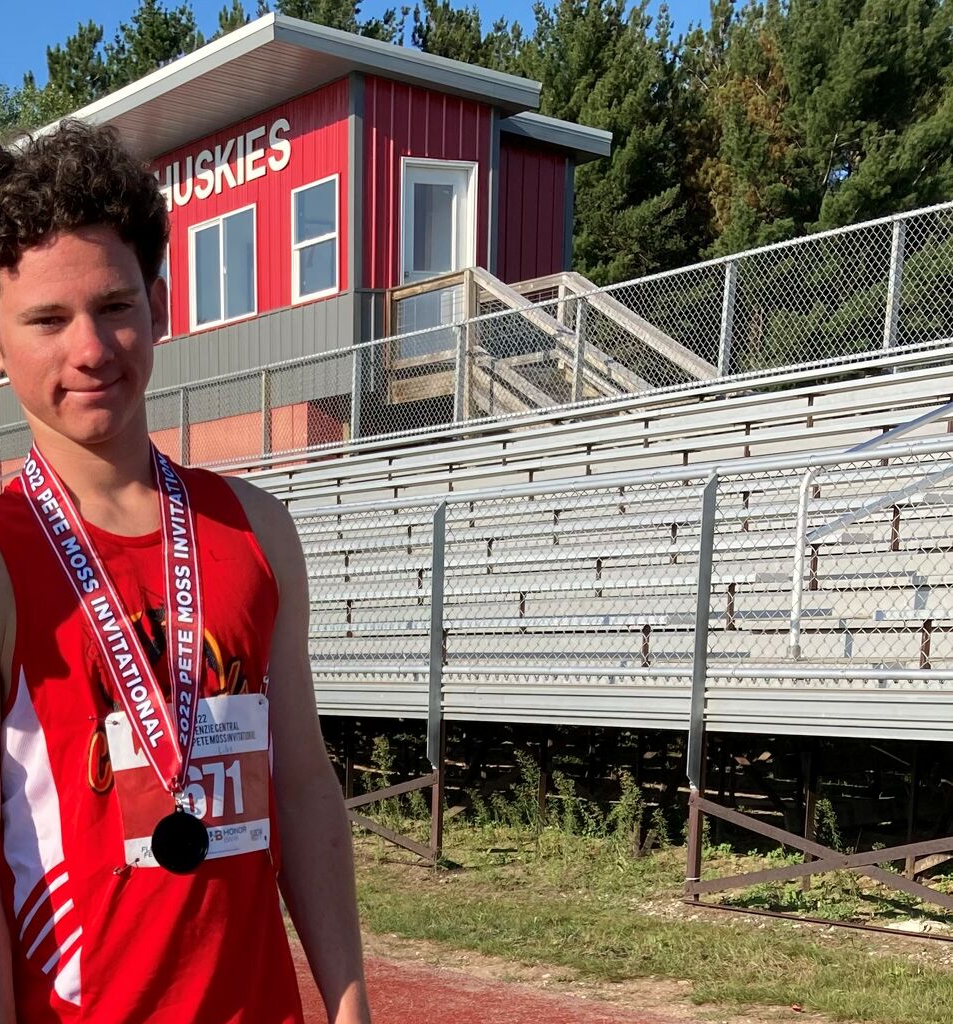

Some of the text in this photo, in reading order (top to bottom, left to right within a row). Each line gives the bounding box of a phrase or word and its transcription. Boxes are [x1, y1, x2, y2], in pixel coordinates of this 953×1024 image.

[154, 118, 291, 213] HUSKIES
[37, 487, 71, 536] PETE
[61, 536, 100, 593] MOSS
[90, 595, 165, 748] INVITATIONAL
[157, 453, 194, 746] 2022 PETE MOSS INVITATION
[195, 724, 215, 735] ENZIE
[184, 759, 245, 821] 671
